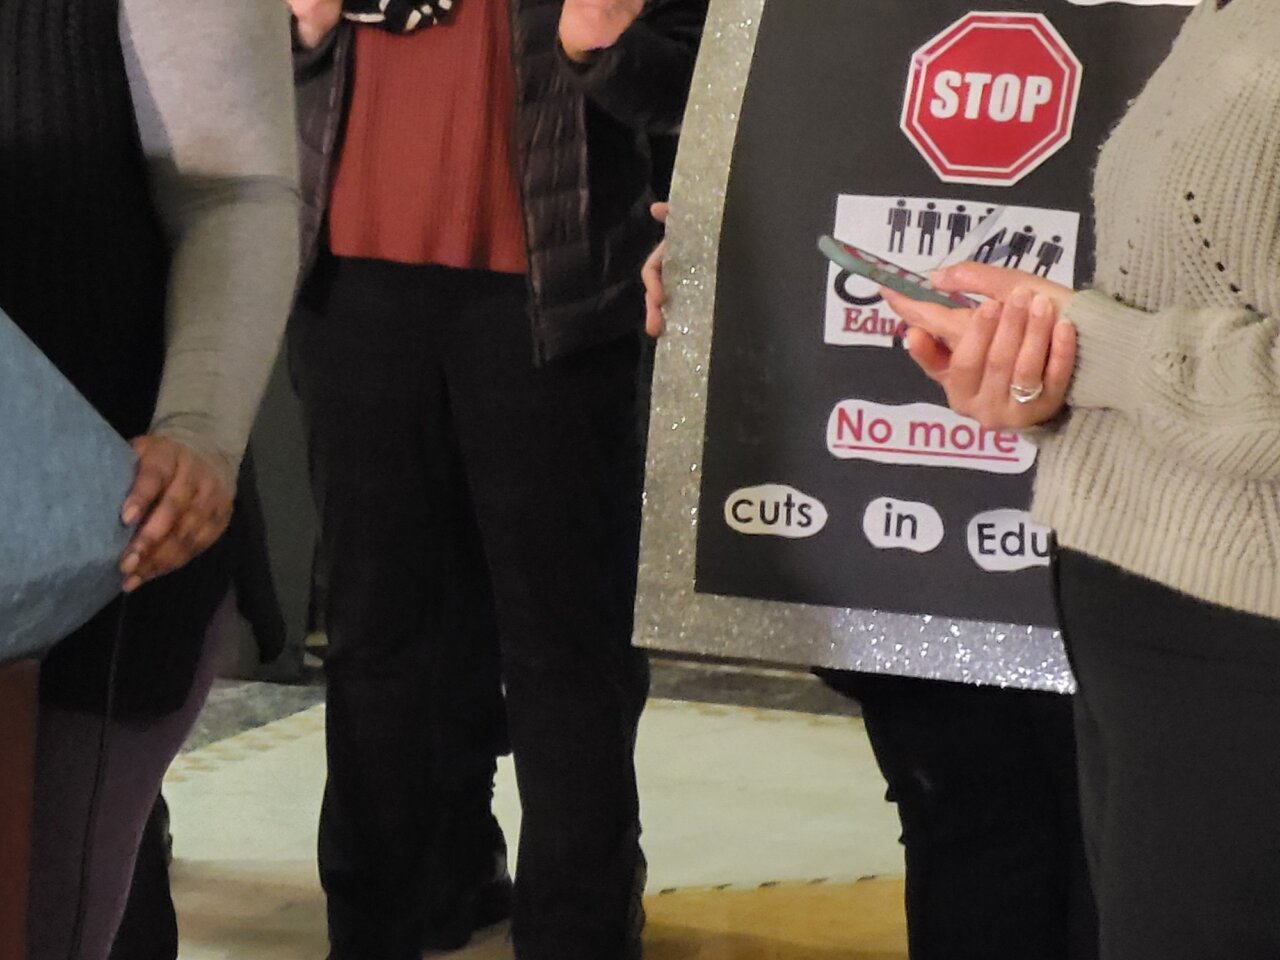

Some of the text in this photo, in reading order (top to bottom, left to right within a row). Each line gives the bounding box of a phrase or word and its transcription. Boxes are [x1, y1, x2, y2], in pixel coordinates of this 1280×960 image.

[930, 70, 1053, 123] STOP
[835, 406, 1020, 454] No more
[730, 492, 1050, 558] cuts in Edu
